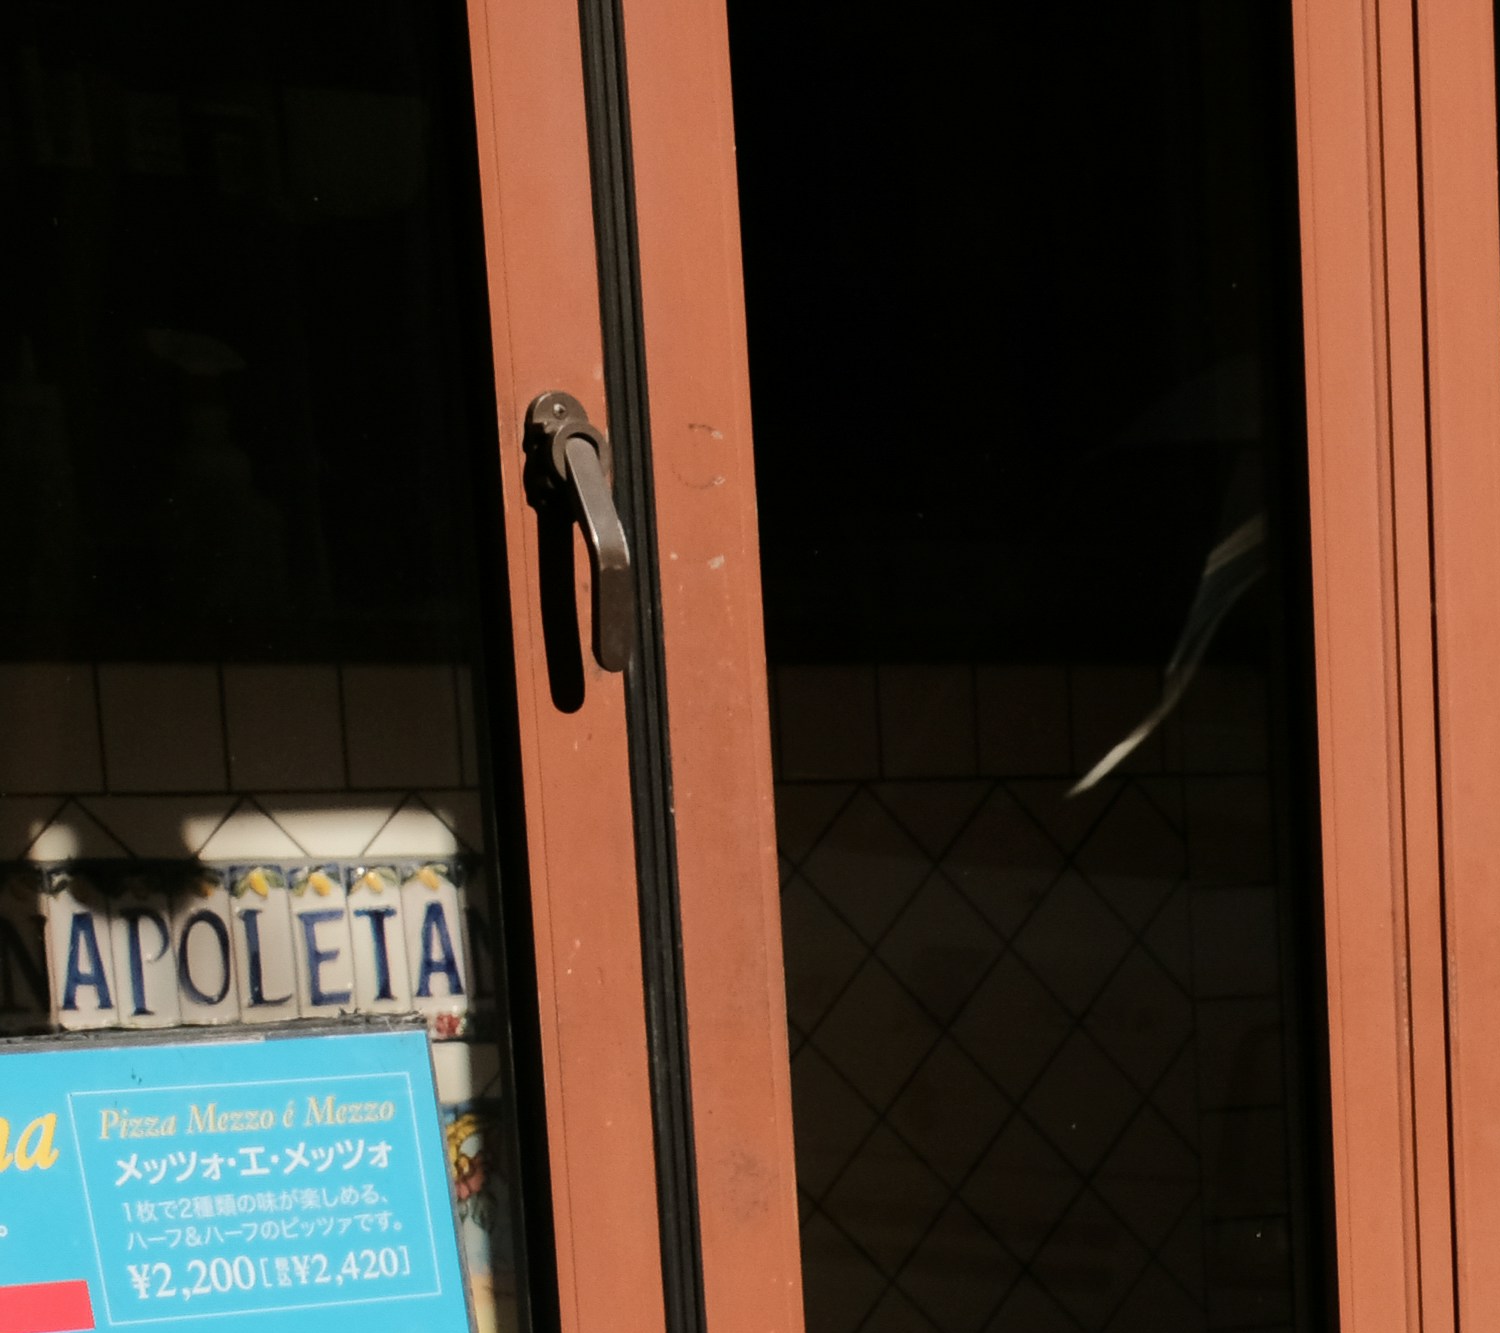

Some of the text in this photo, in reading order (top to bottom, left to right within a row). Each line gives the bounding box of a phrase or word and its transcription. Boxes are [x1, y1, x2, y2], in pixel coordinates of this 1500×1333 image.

[99, 1108, 177, 1140] Pizza
[186, 1102, 275, 1135] Mezzo
[304, 1095, 396, 1126] Mezzo
